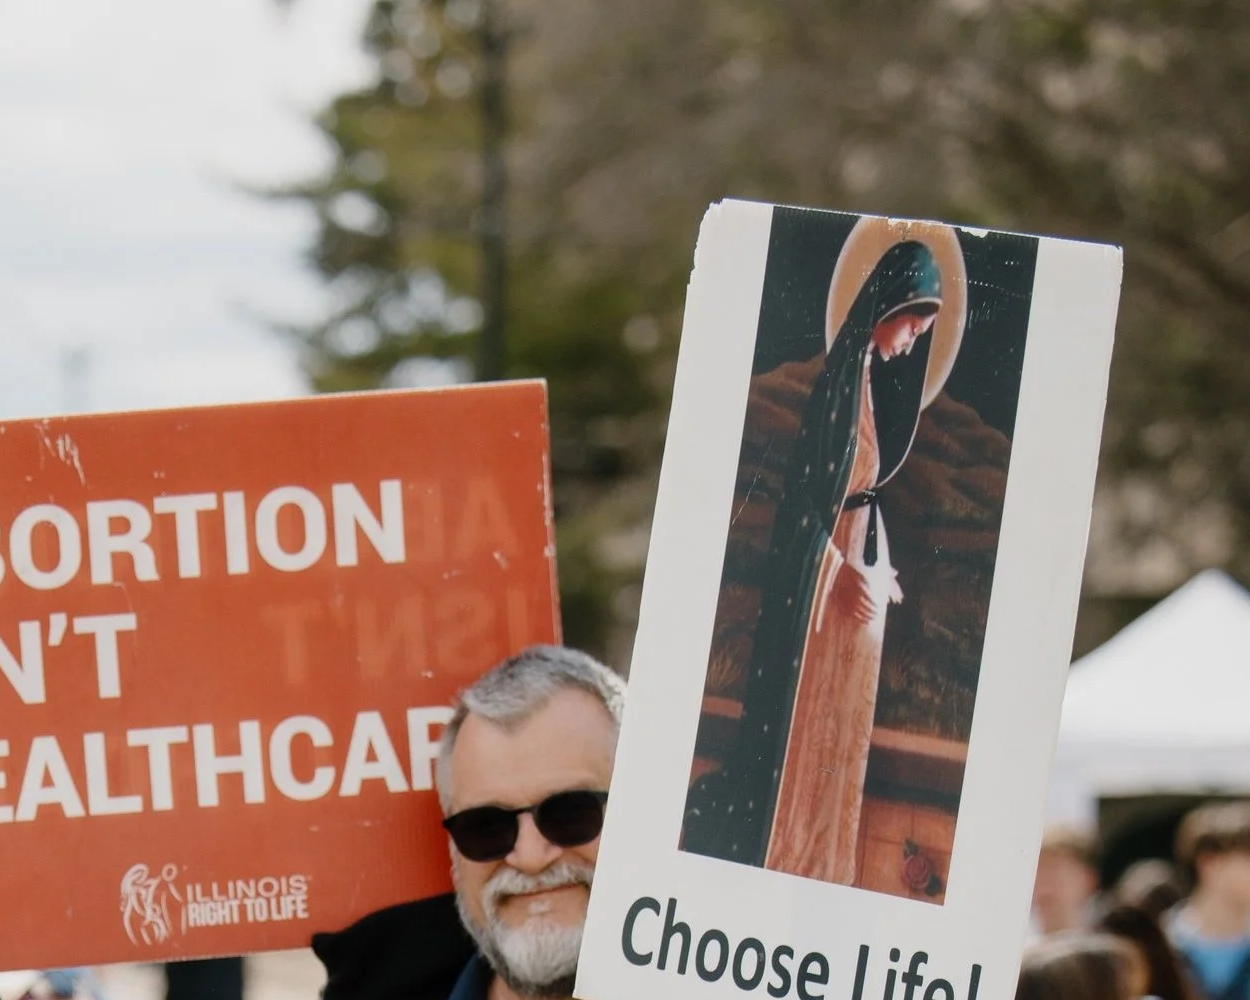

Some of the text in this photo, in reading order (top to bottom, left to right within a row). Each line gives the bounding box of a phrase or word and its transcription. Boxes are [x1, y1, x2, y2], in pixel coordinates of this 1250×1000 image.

[186, 874, 309, 903] ILLINOIS
[188, 894, 310, 927] RIGHT TO LIFE
